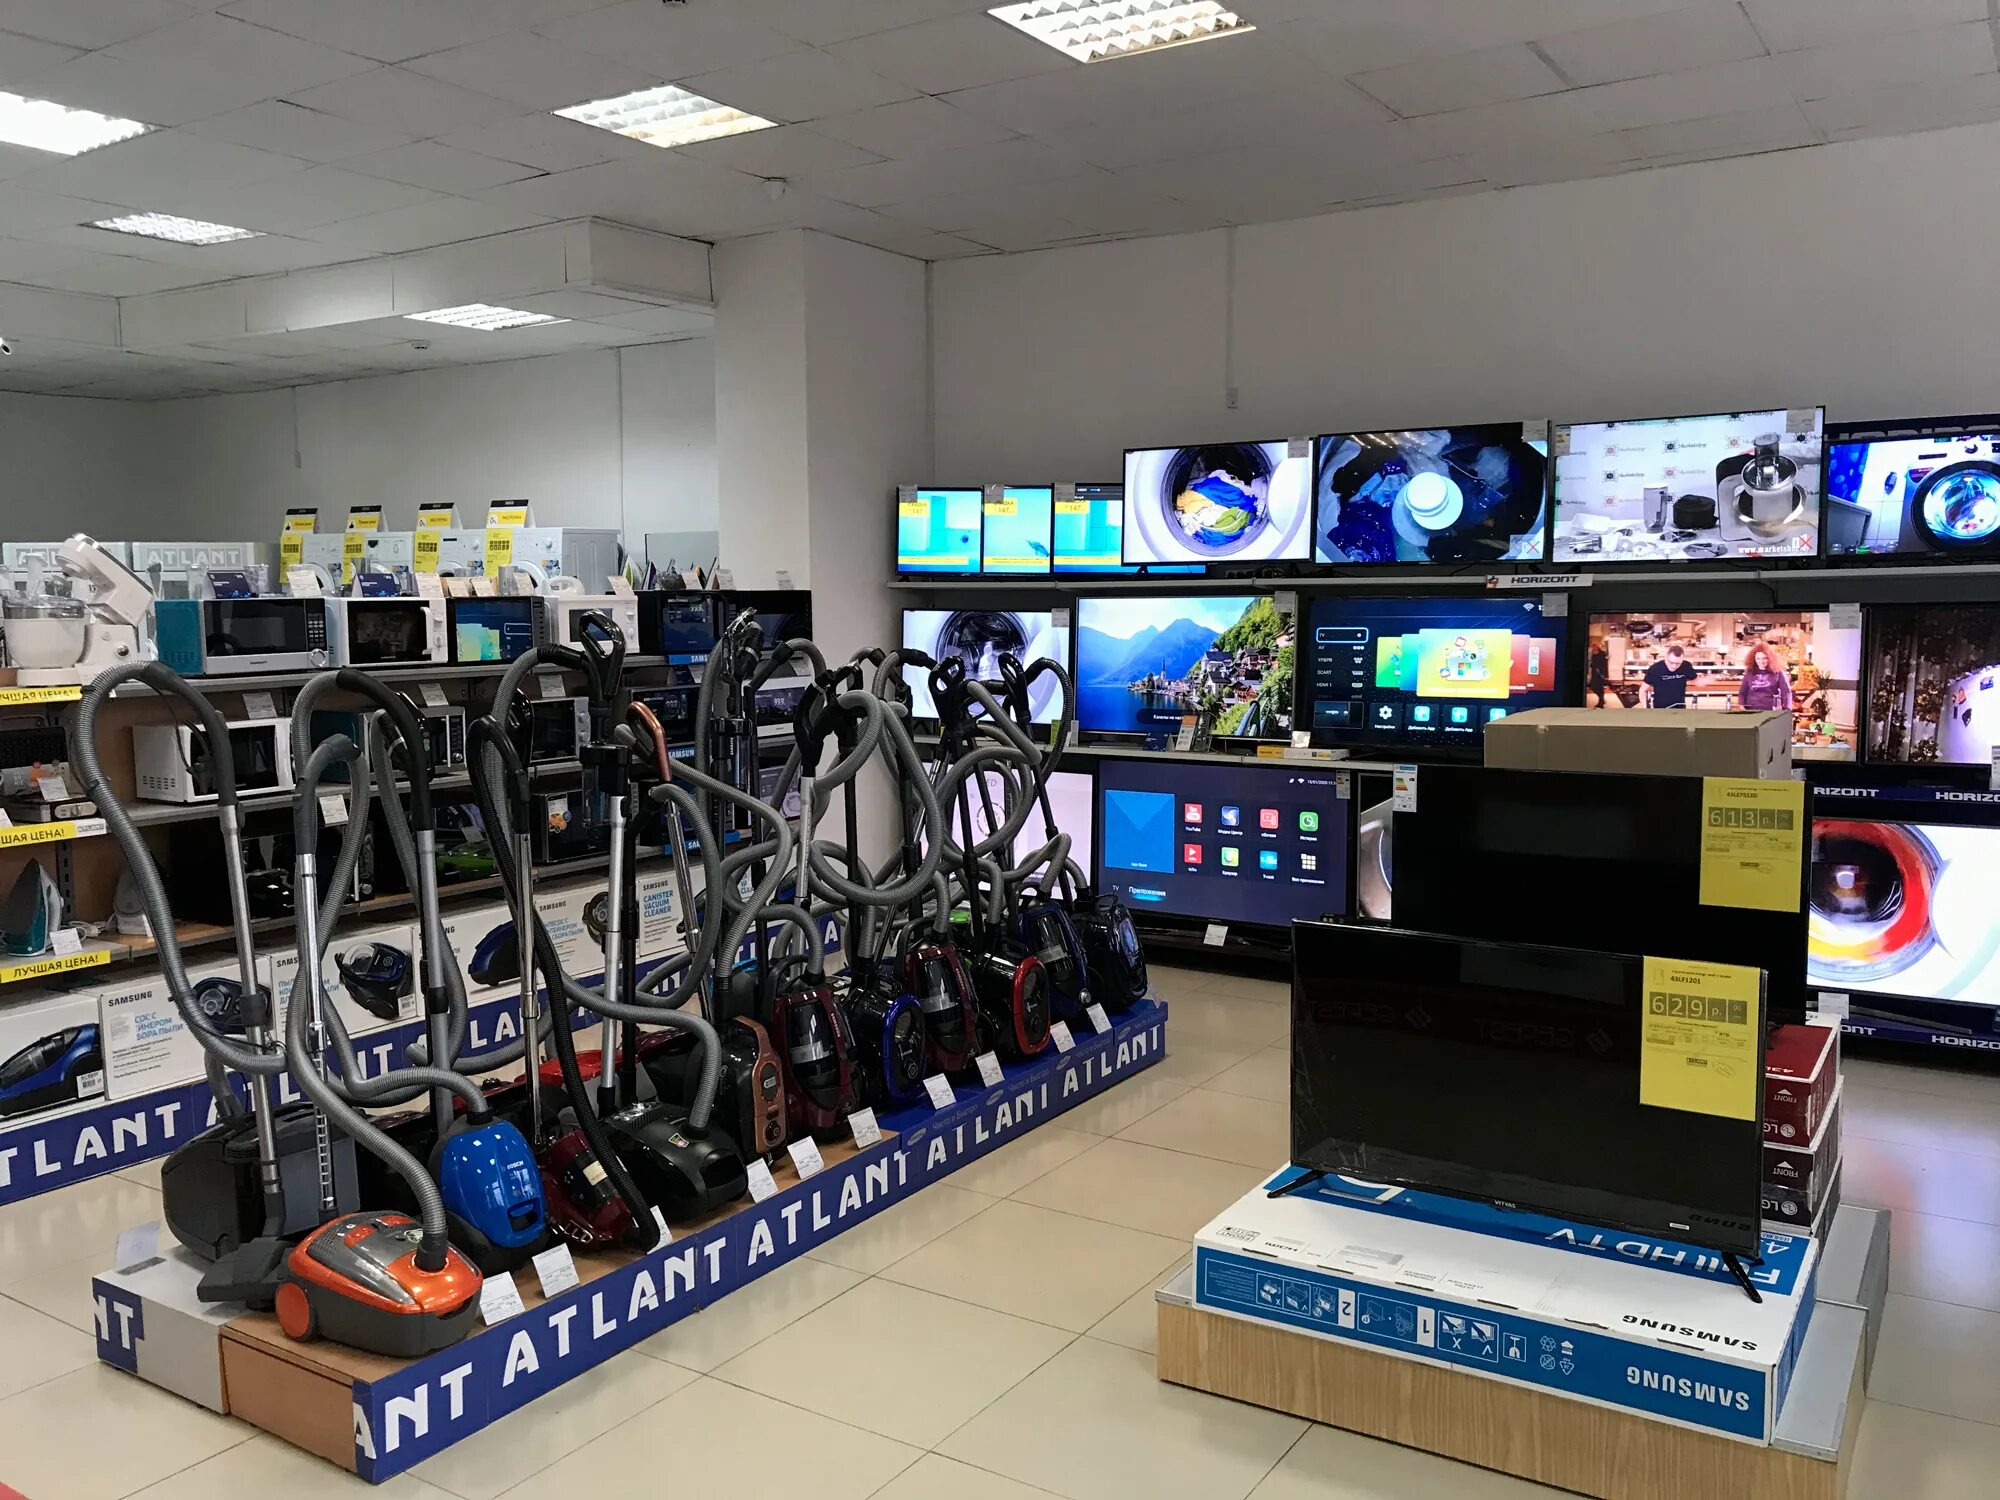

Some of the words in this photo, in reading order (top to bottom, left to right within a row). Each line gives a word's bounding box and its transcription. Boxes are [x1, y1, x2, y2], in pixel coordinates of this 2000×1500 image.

[1510, 574, 1579, 585] HORIZONT
[668, 748, 695, 758] SAMSUN
[1813, 786, 1879, 797] RIZONT
[31, 828, 65, 841] ЦЕНА!
[643, 880, 669, 891] SAMSUNG
[1128, 886, 1166, 897] Приложения
[643, 890, 673, 902] CANISTER
[539, 900, 567, 912] SAMSUNG
[643, 899, 670, 910] VACUUM
[643, 905, 672, 918] CLEANER
[13, 959, 63, 979] ЛУЧШАЯ
[66, 954, 99, 970] ЦЕНА!
[108, 990, 153, 1008] SAMSUNG
[1652, 995, 1703, 1018] 629
[1063, 1024, 1162, 1099] ATLANT
[1773, 1094, 1797, 1104] FRONT
[506, 1160, 524, 1170] BOSCH
[1772, 1167, 1799, 1178] FRONT
[747, 1150, 912, 1268] ATLANT
[1762, 1200, 1779, 1212] LG
[1545, 1228, 1606, 1251] TV
[1616, 1241, 1687, 1266] HD
[503, 1236, 727, 1388] ATLANT
[1341, 1301, 1352, 1316] 2
[1422, 1318, 1431, 1334] 1
[1622, 1314, 1759, 1352] SAMSUNG
[1626, 1365, 1750, 1412] SAMSUNG
